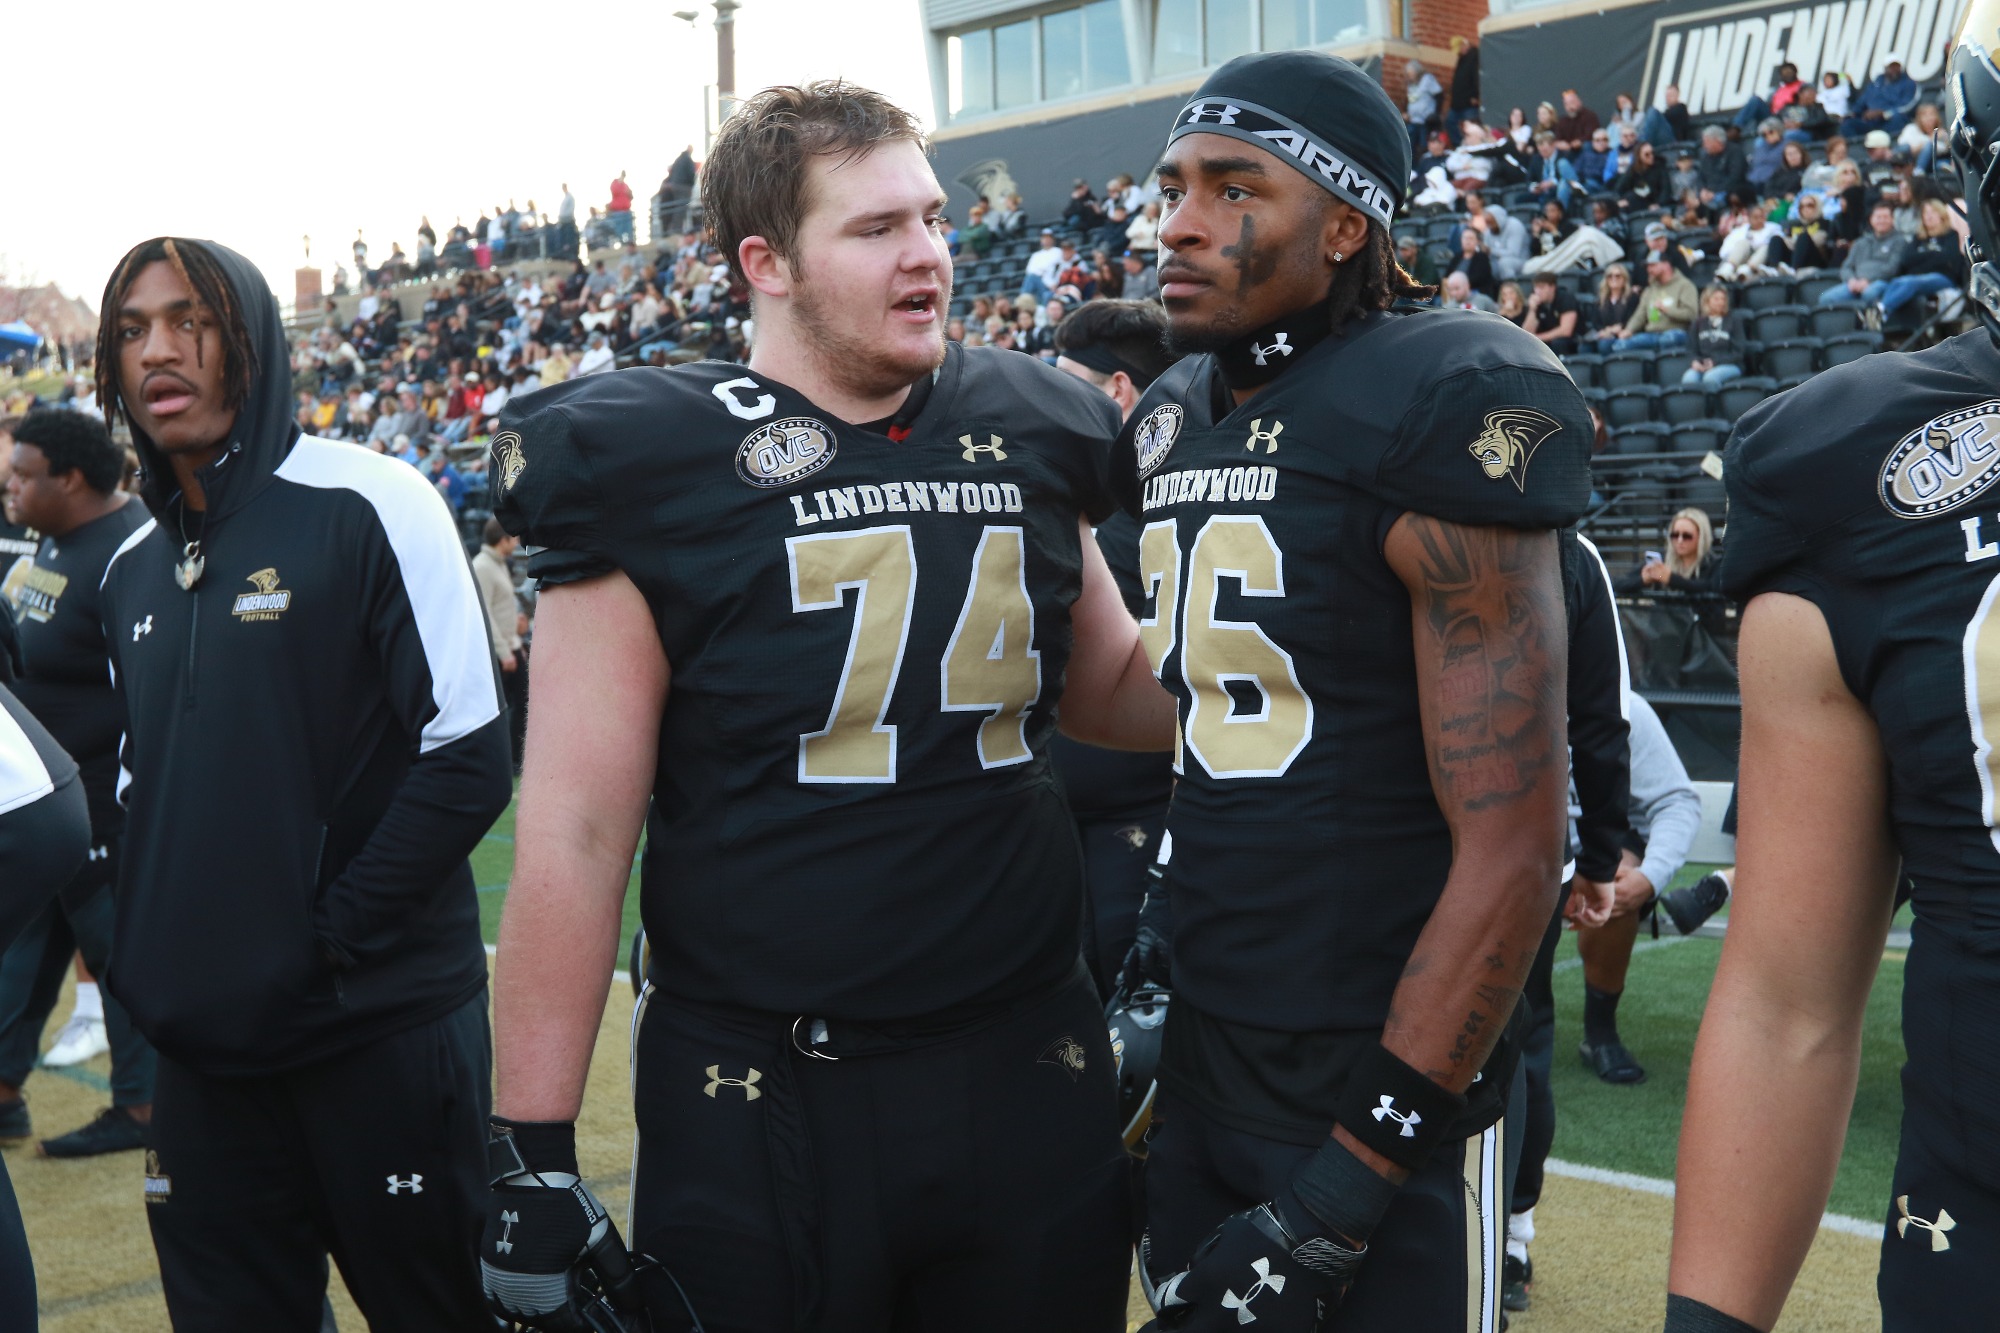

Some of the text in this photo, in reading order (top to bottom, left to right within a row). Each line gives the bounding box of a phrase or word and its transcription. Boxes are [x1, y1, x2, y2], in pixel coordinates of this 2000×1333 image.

[1653, 0, 1966, 115] LINDENWOO
[712, 377, 776, 420] C
[757, 431, 818, 475] OVC
[1908, 421, 1997, 498] OVC
[790, 481, 1024, 526] LINDENWOOD
[1142, 466, 1278, 512] LINDENWOOD
[235, 593, 288, 612] LINDENWOOD
[241, 612, 280, 622] FOOTBALL
[785, 525, 1041, 784] 74
